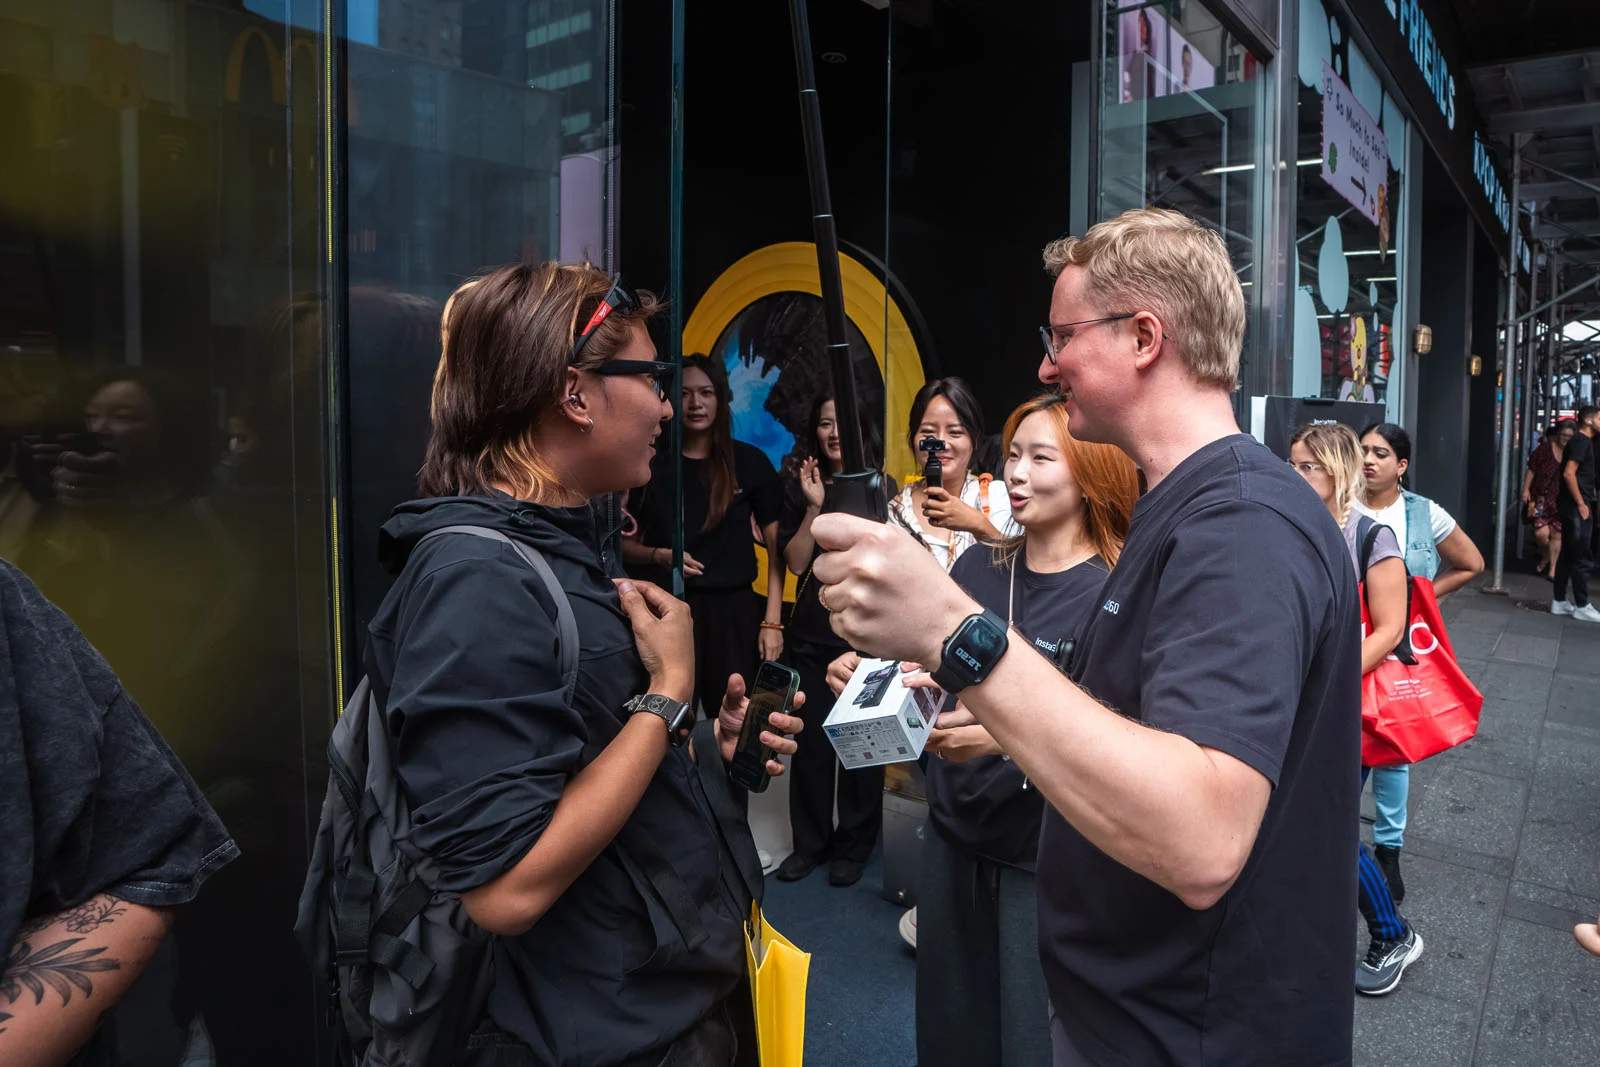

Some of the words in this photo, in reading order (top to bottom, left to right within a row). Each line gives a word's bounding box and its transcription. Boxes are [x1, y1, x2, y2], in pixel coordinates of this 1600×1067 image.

[1399, 0, 1456, 131] FRIENDS
[1336, 92, 1344, 117] So
[1346, 105, 1362, 140] Much
[1364, 124, 1370, 147] to
[955, 647, 982, 672] 12:20
[1035, 636, 1057, 653] Insta3
